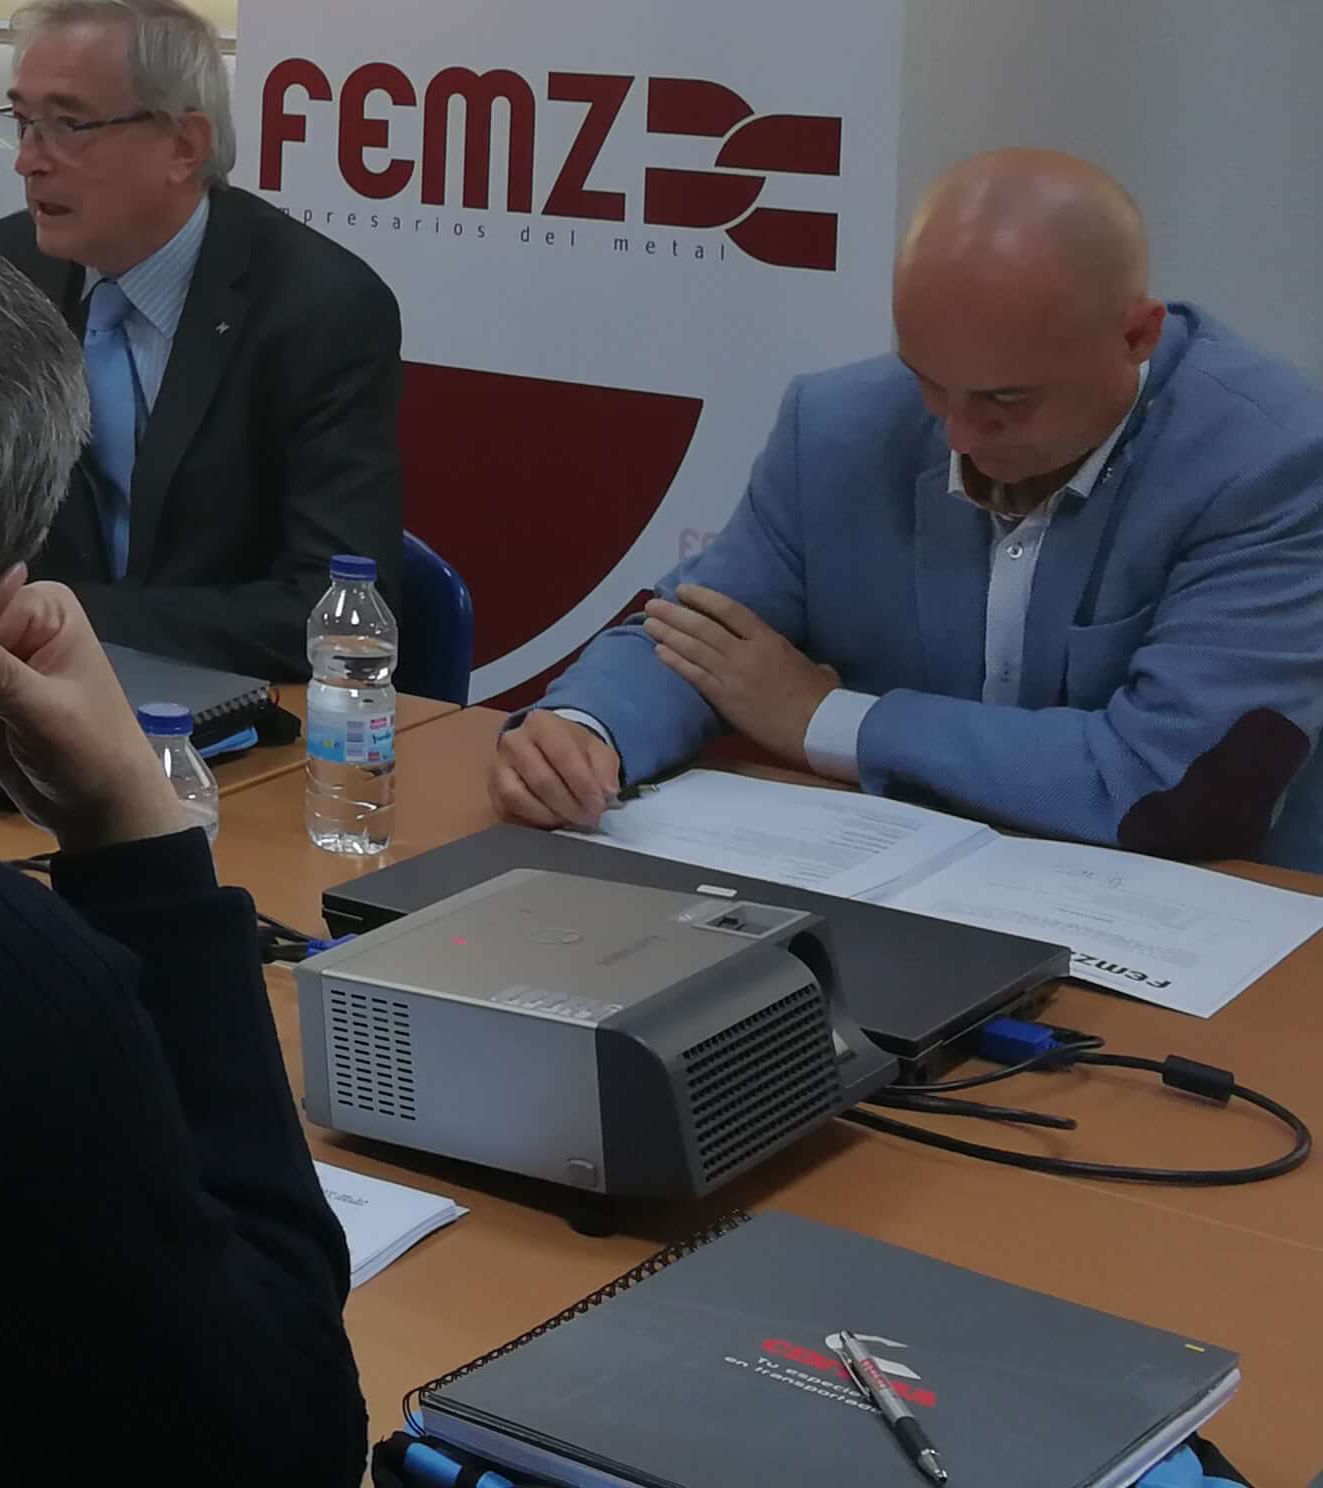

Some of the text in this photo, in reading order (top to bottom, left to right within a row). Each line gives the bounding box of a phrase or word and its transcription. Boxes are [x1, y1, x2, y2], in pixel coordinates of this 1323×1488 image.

[520, 224, 576, 248] del
[613, 235, 725, 261] metal
[724, 1356, 748, 1367] en
[757, 1357, 779, 1369] Tu
[785, 1368, 861, 1398] especia
